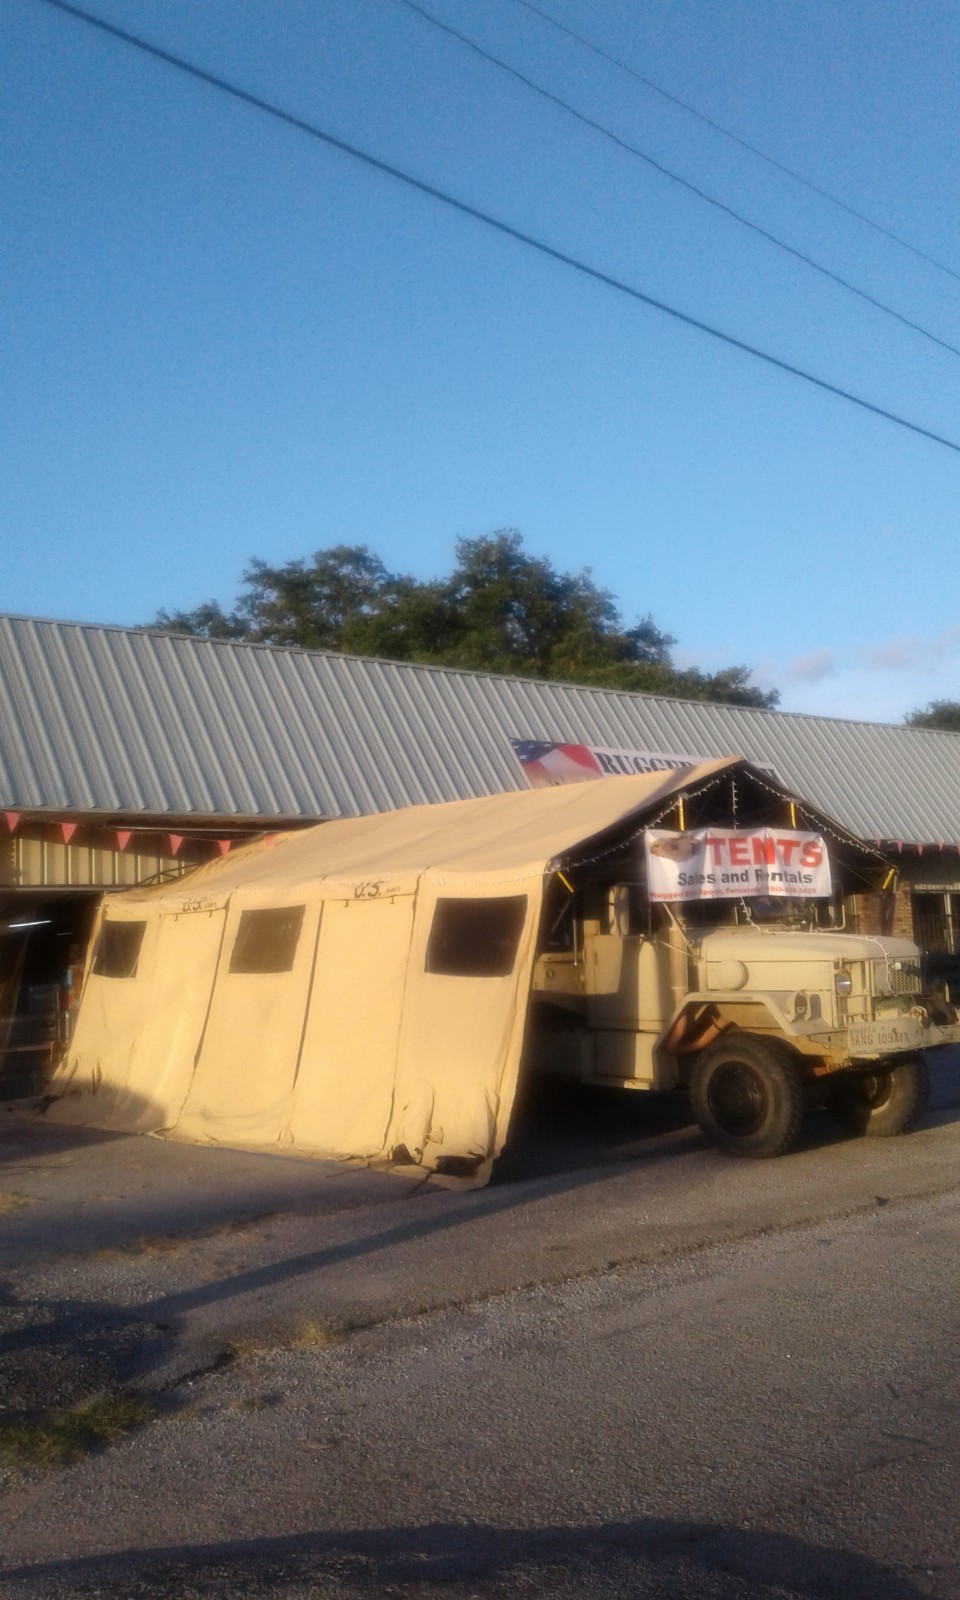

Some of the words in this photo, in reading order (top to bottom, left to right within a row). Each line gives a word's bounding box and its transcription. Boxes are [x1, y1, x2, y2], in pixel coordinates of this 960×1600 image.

[594, 752, 696, 775] RUGG
[705, 837, 823, 867] TENTS
[678, 870, 716, 887] Sales
[721, 869, 749, 884] and
